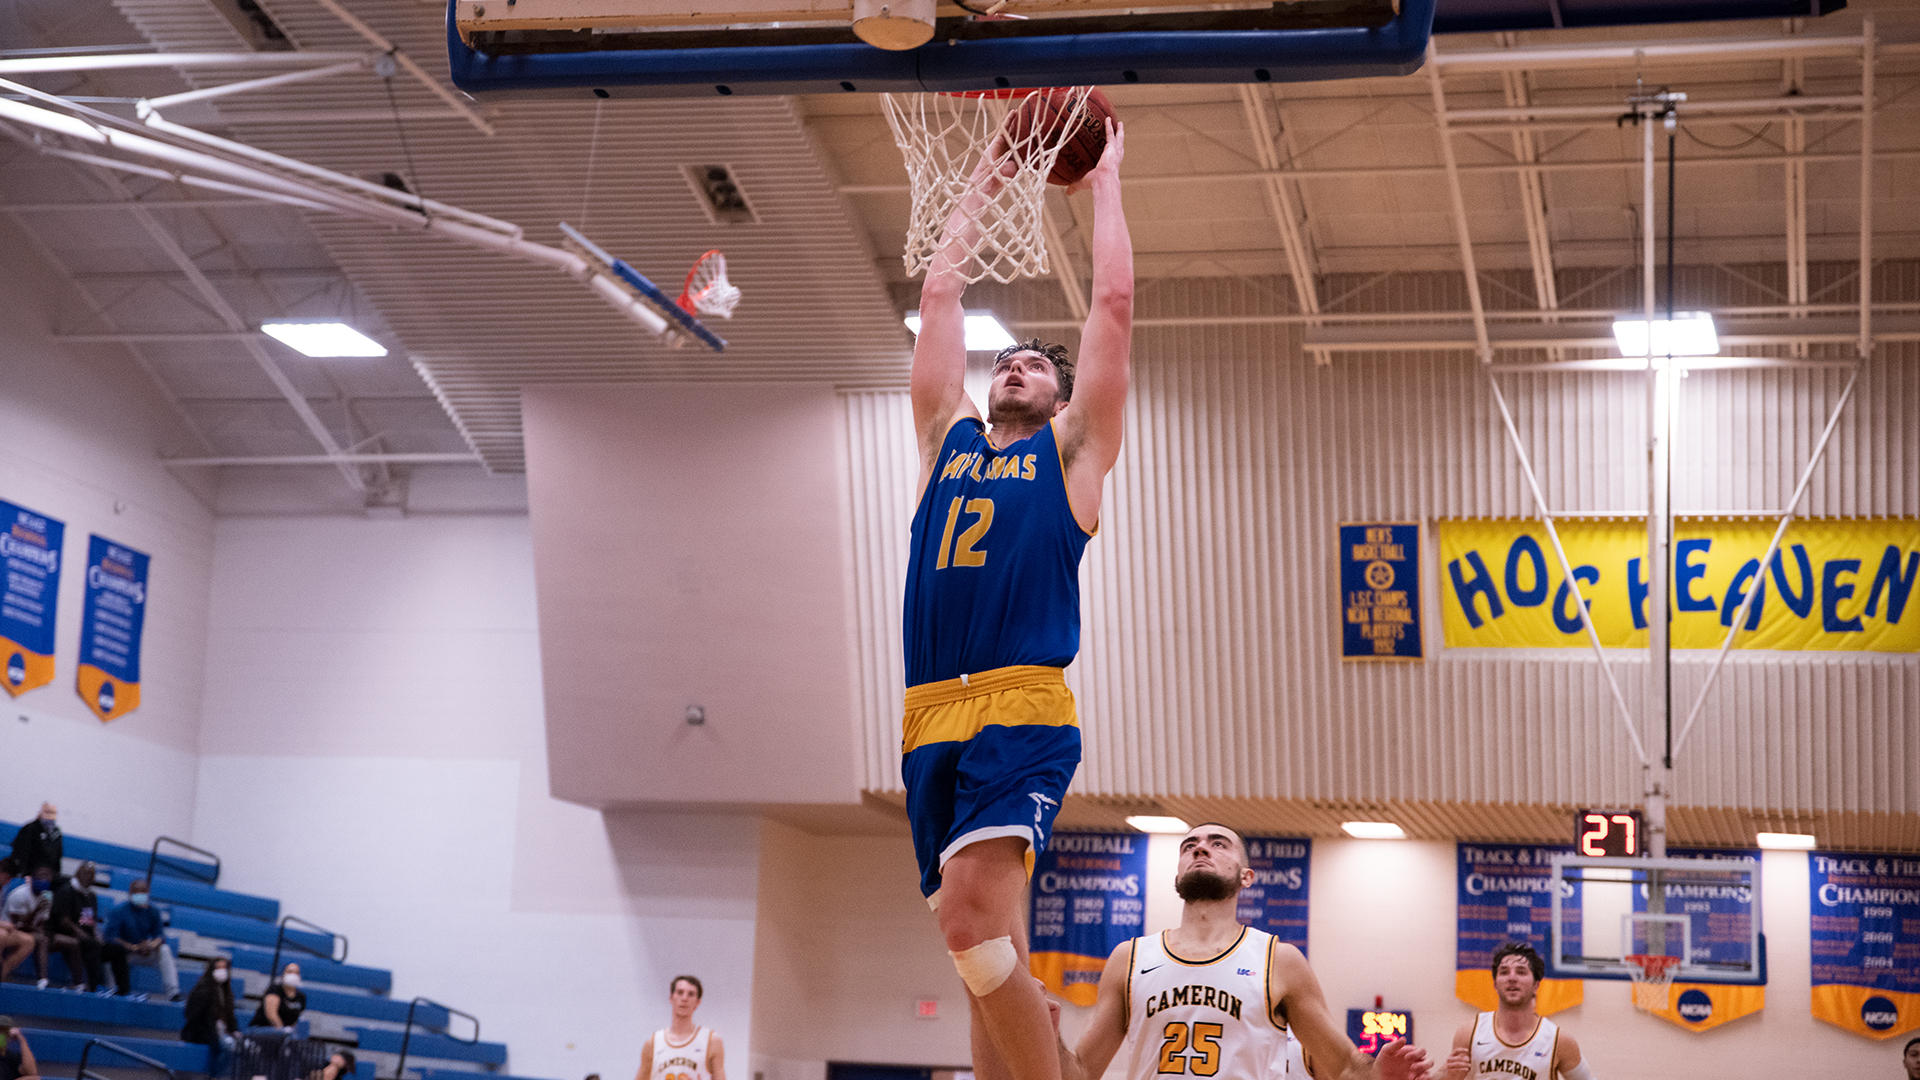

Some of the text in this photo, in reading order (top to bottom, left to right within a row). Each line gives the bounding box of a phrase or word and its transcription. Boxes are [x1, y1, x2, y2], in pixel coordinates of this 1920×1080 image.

[936, 496, 994, 570] 12
[1353, 544, 1405, 561] BASKETBALL
[1448, 535, 1600, 634] HOG
[1048, 834, 1135, 855] FOOTBALL
[1582, 814, 1635, 857] 27
[1266, 842, 1306, 859] FIELD
[1464, 847, 1514, 864] TRACK
[1518, 848, 1531, 865] &
[1814, 856, 1920, 877] TRACK & FIE
[1040, 871, 1139, 897] CHAMPIONS
[1253, 867, 1302, 891] PIONS
[1465, 873, 1575, 900] CHAMPIOS
[1819, 883, 1920, 906] CHAMPION
[1146, 985, 1243, 1021] CAMERON
[1863, 1011, 1897, 1024] NCAA
[1158, 1021, 1223, 1077] 25
[1479, 1058, 1537, 1080] CAMERON
